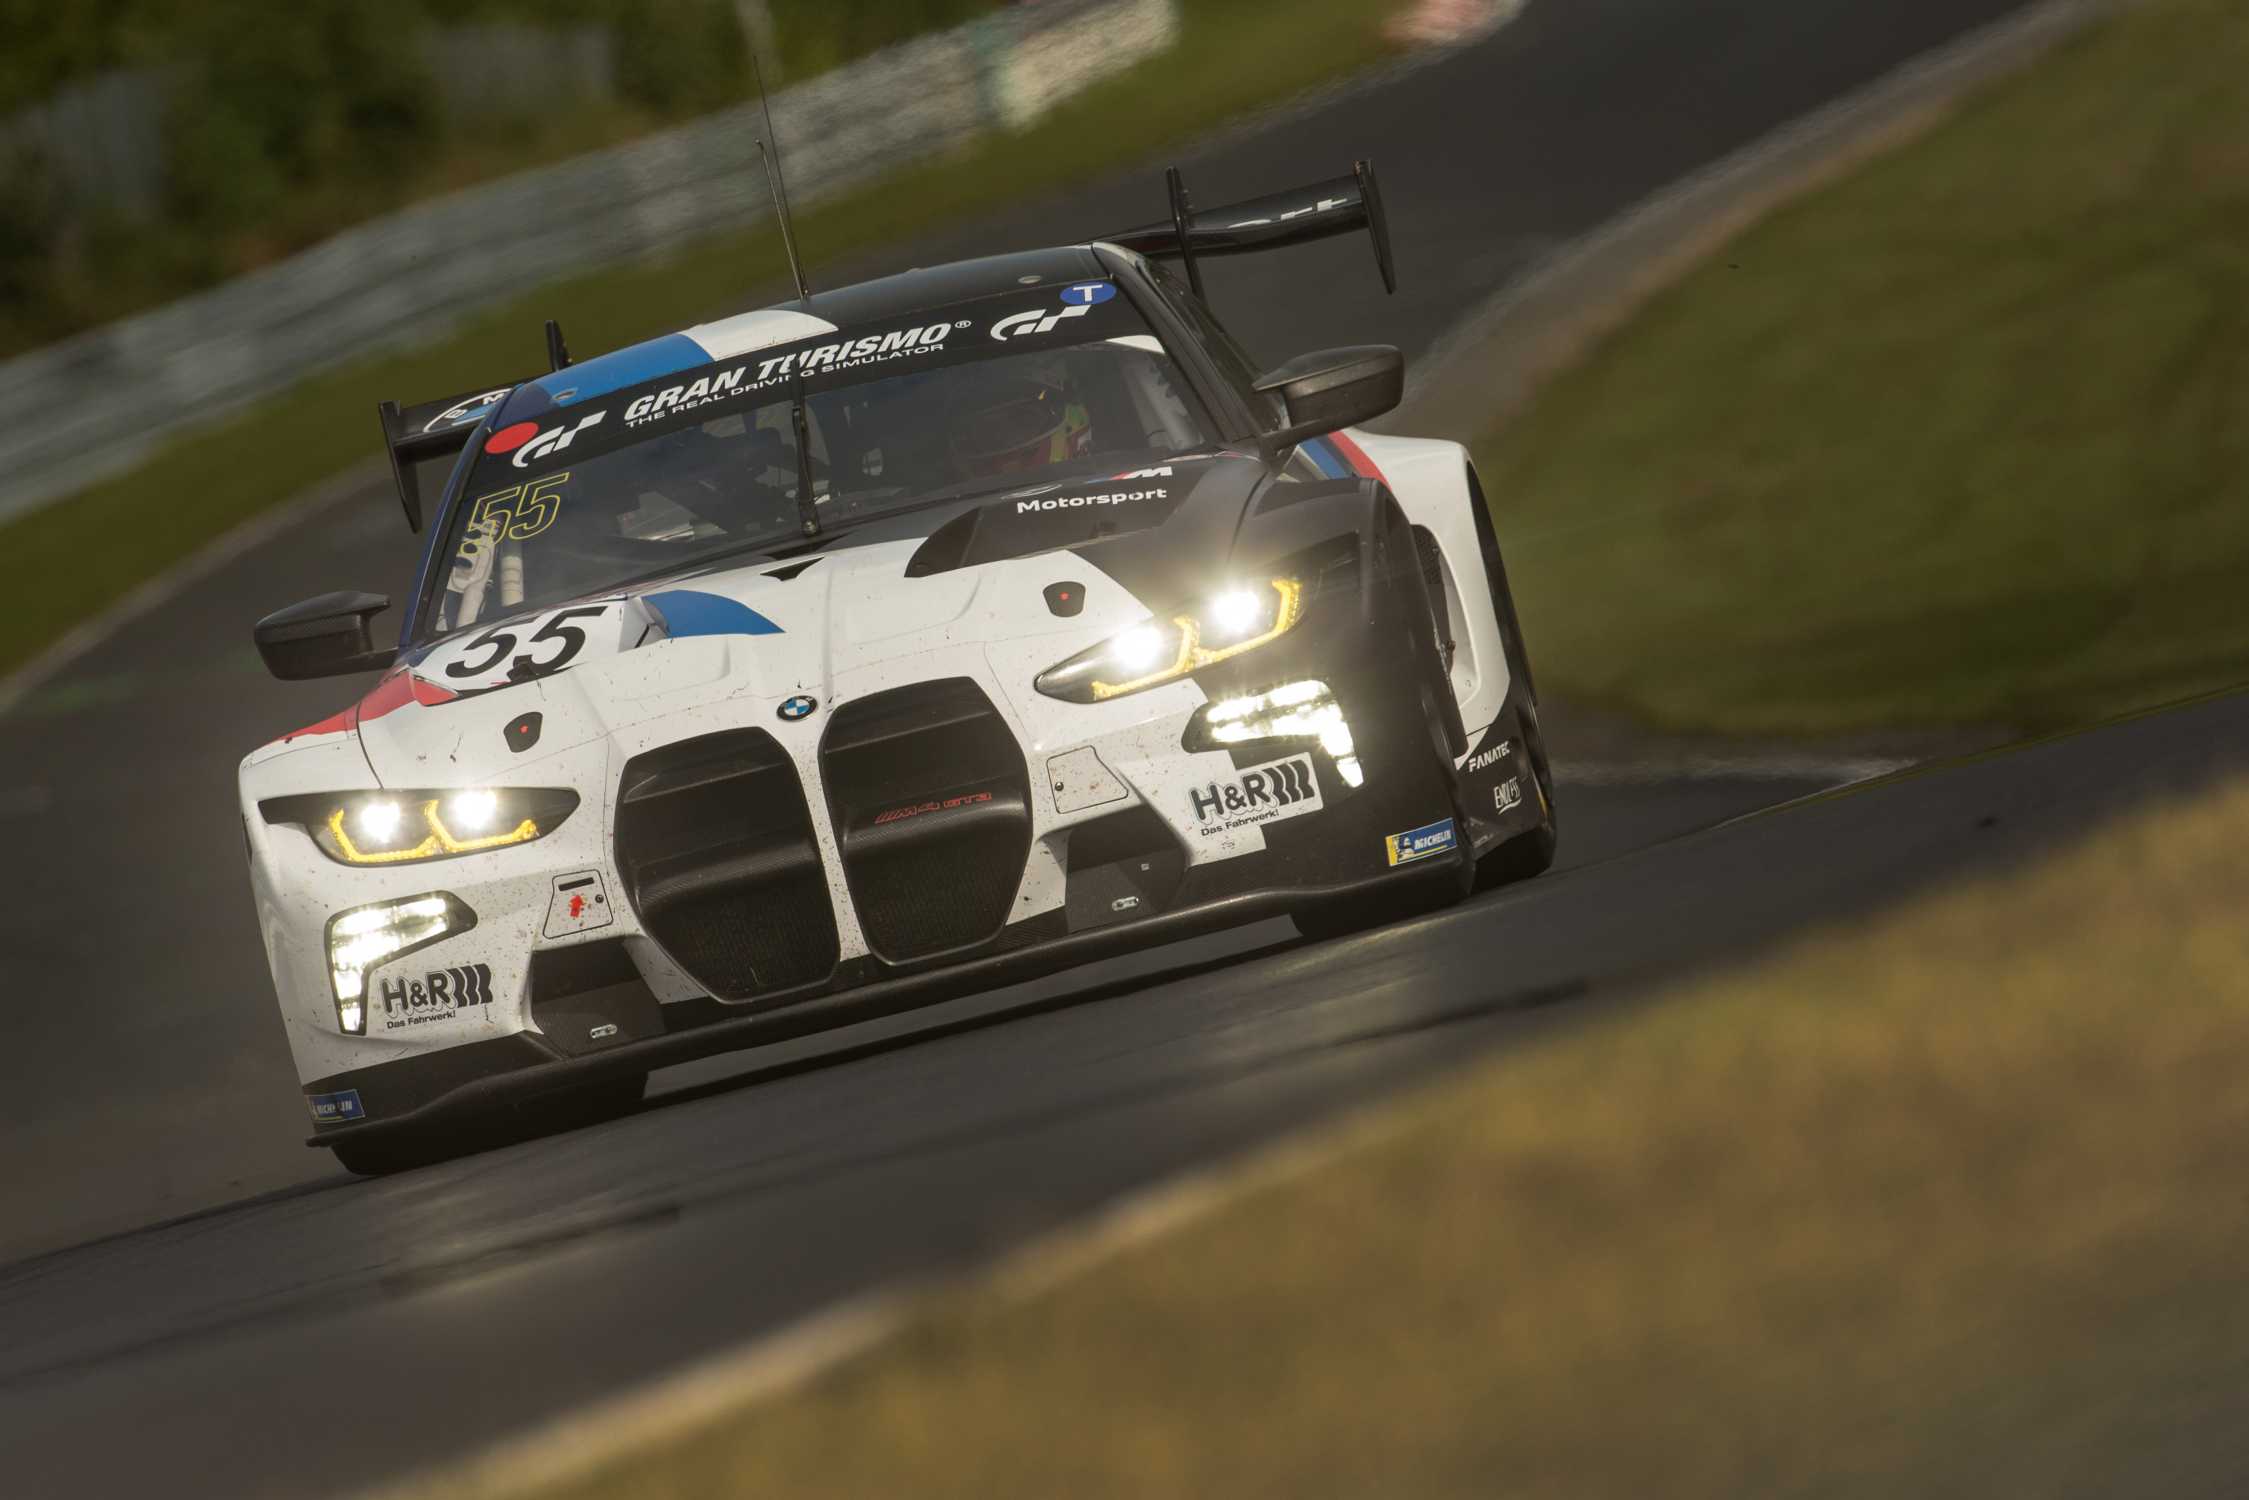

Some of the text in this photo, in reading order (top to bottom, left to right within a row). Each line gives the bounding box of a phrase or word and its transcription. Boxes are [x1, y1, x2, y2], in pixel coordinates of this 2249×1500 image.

[624, 366, 746, 421] GRAN
[625, 411, 666, 428] THE
[672, 394, 725, 414] REAL
[820, 343, 944, 373] SIMULATOR
[460, 472, 569, 555] 55
[1016, 488, 1168, 514] Motorsport
[445, 605, 608, 678] 55
[1468, 740, 1510, 772] FANATEC
[1201, 809, 1280, 837] Das Fahrwerk!
[1414, 829, 1452, 851] MICHELIN
[387, 1010, 456, 1029] Das Fahrwerk!
